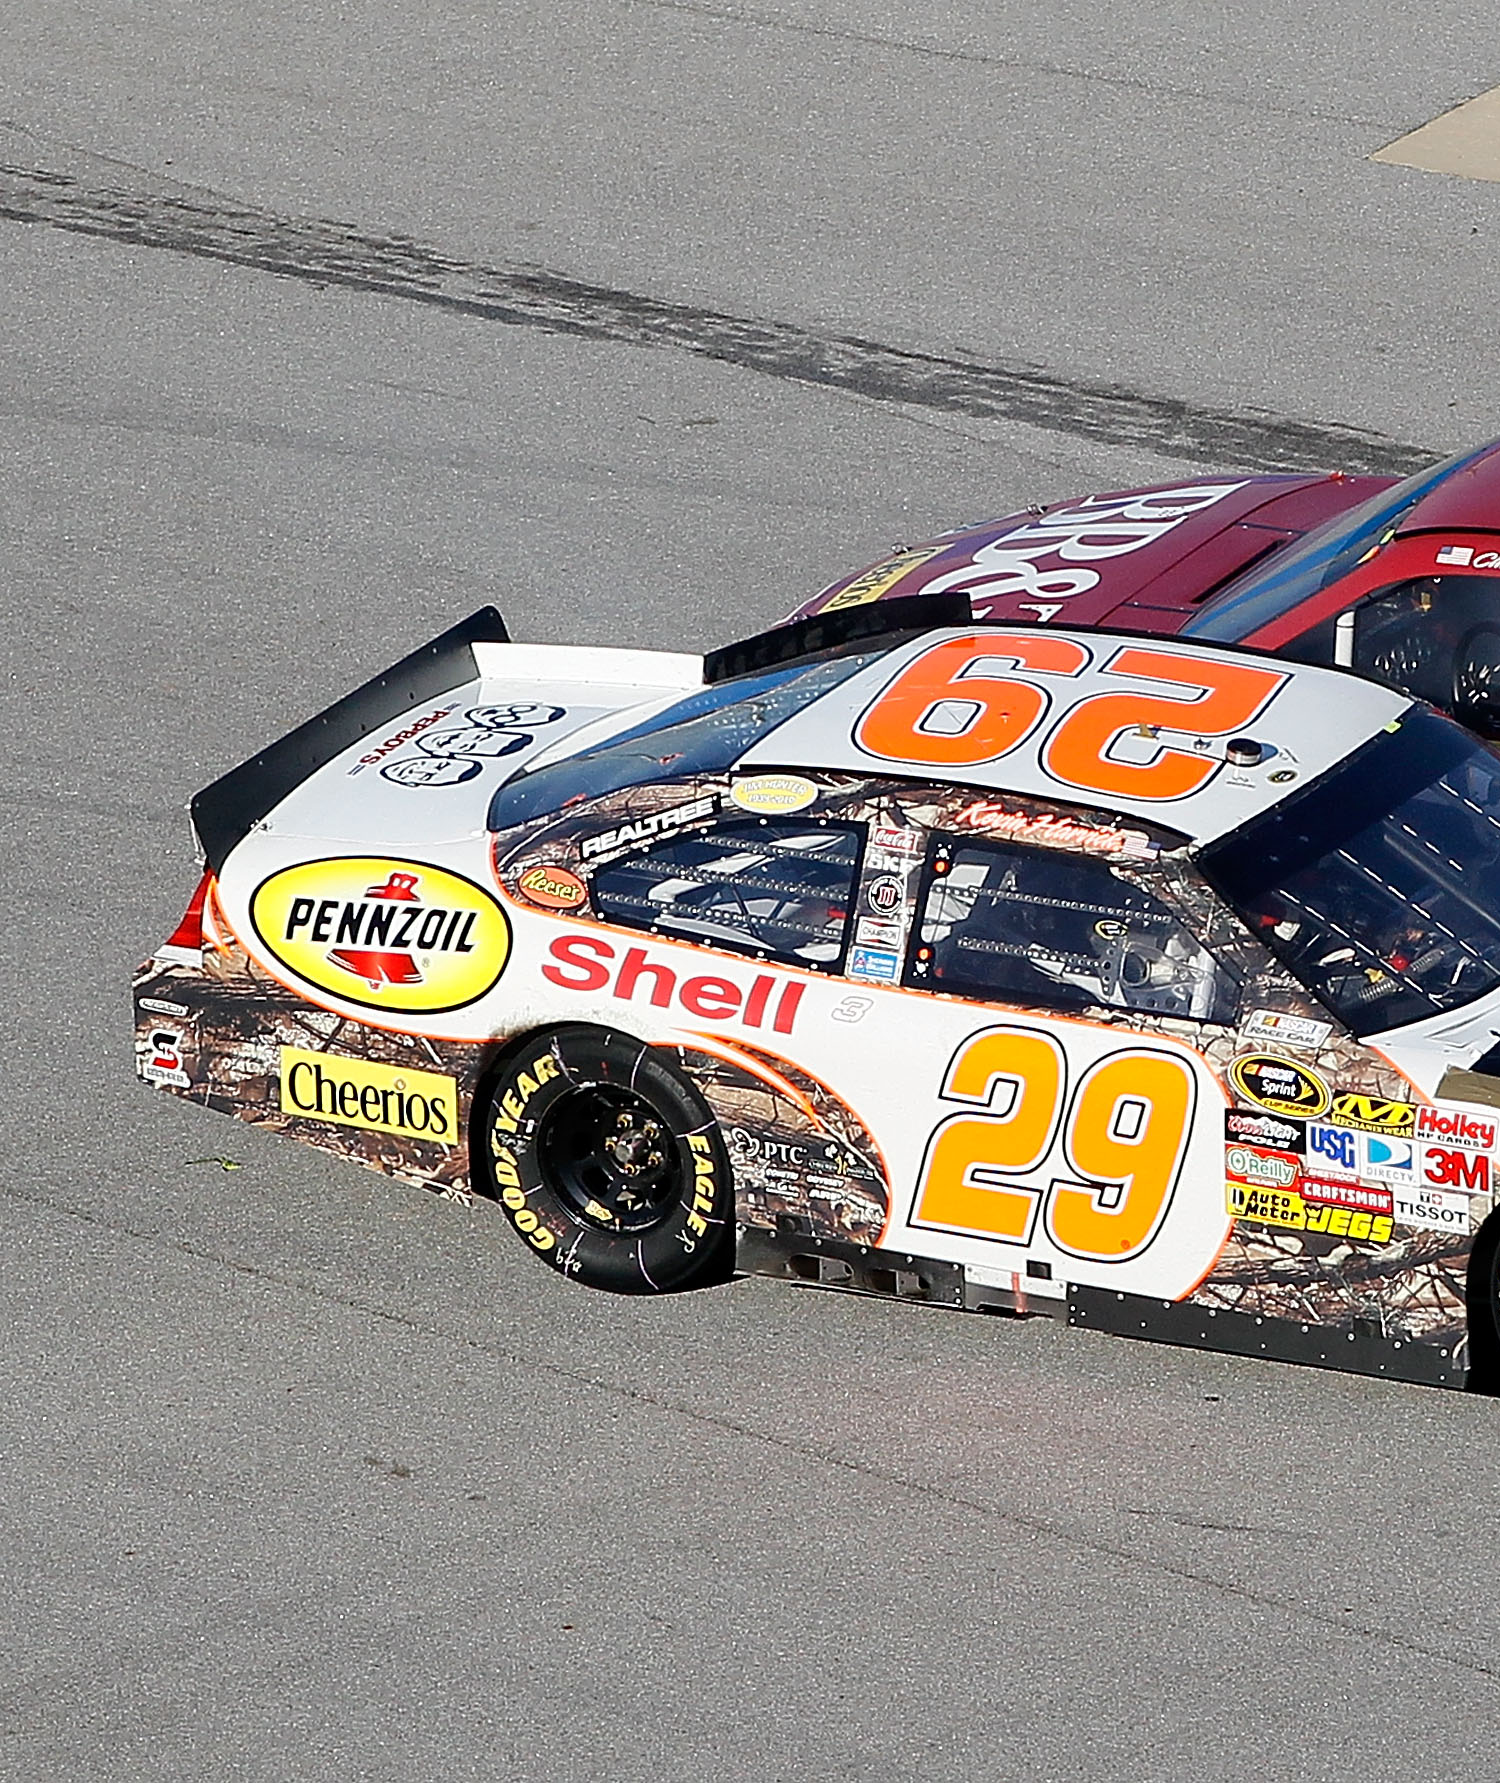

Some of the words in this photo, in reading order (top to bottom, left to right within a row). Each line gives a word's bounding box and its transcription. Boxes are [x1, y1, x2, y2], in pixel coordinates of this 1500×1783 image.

[850, 632, 1295, 803] 29
[582, 796, 714, 858] REALTREE
[520, 869, 580, 902] Reese's
[285, 898, 478, 953] PENNZOIL
[541, 935, 805, 1036] Shell
[1250, 1026, 1284, 1041] RACE
[1287, 1033, 1315, 1045] CAR
[287, 1060, 450, 1137] Cheerios
[1261, 1078, 1297, 1098] Sprint
[906, 1023, 1198, 1263] 29
[1330, 1113, 1383, 1133] MECHANIX
[1384, 1124, 1413, 1138] WEAR
[1418, 1107, 1495, 1149] Holley
[491, 1054, 560, 1250] GOODYEAR
[763, 1141, 805, 1165] PTC
[1229, 1150, 1295, 1185] O'Reilly
[1310, 1126, 1355, 1169] USG
[685, 1134, 715, 1238] EAGLE
[1424, 1147, 1490, 1193] 3M
[1246, 1202, 1300, 1223] Meter
[1248, 1188, 1290, 1208] Auto
[1303, 1182, 1391, 1209] CRAFTSMAN
[1396, 1200, 1467, 1225] TISSOT
[1310, 1205, 1394, 1243] JEGS
